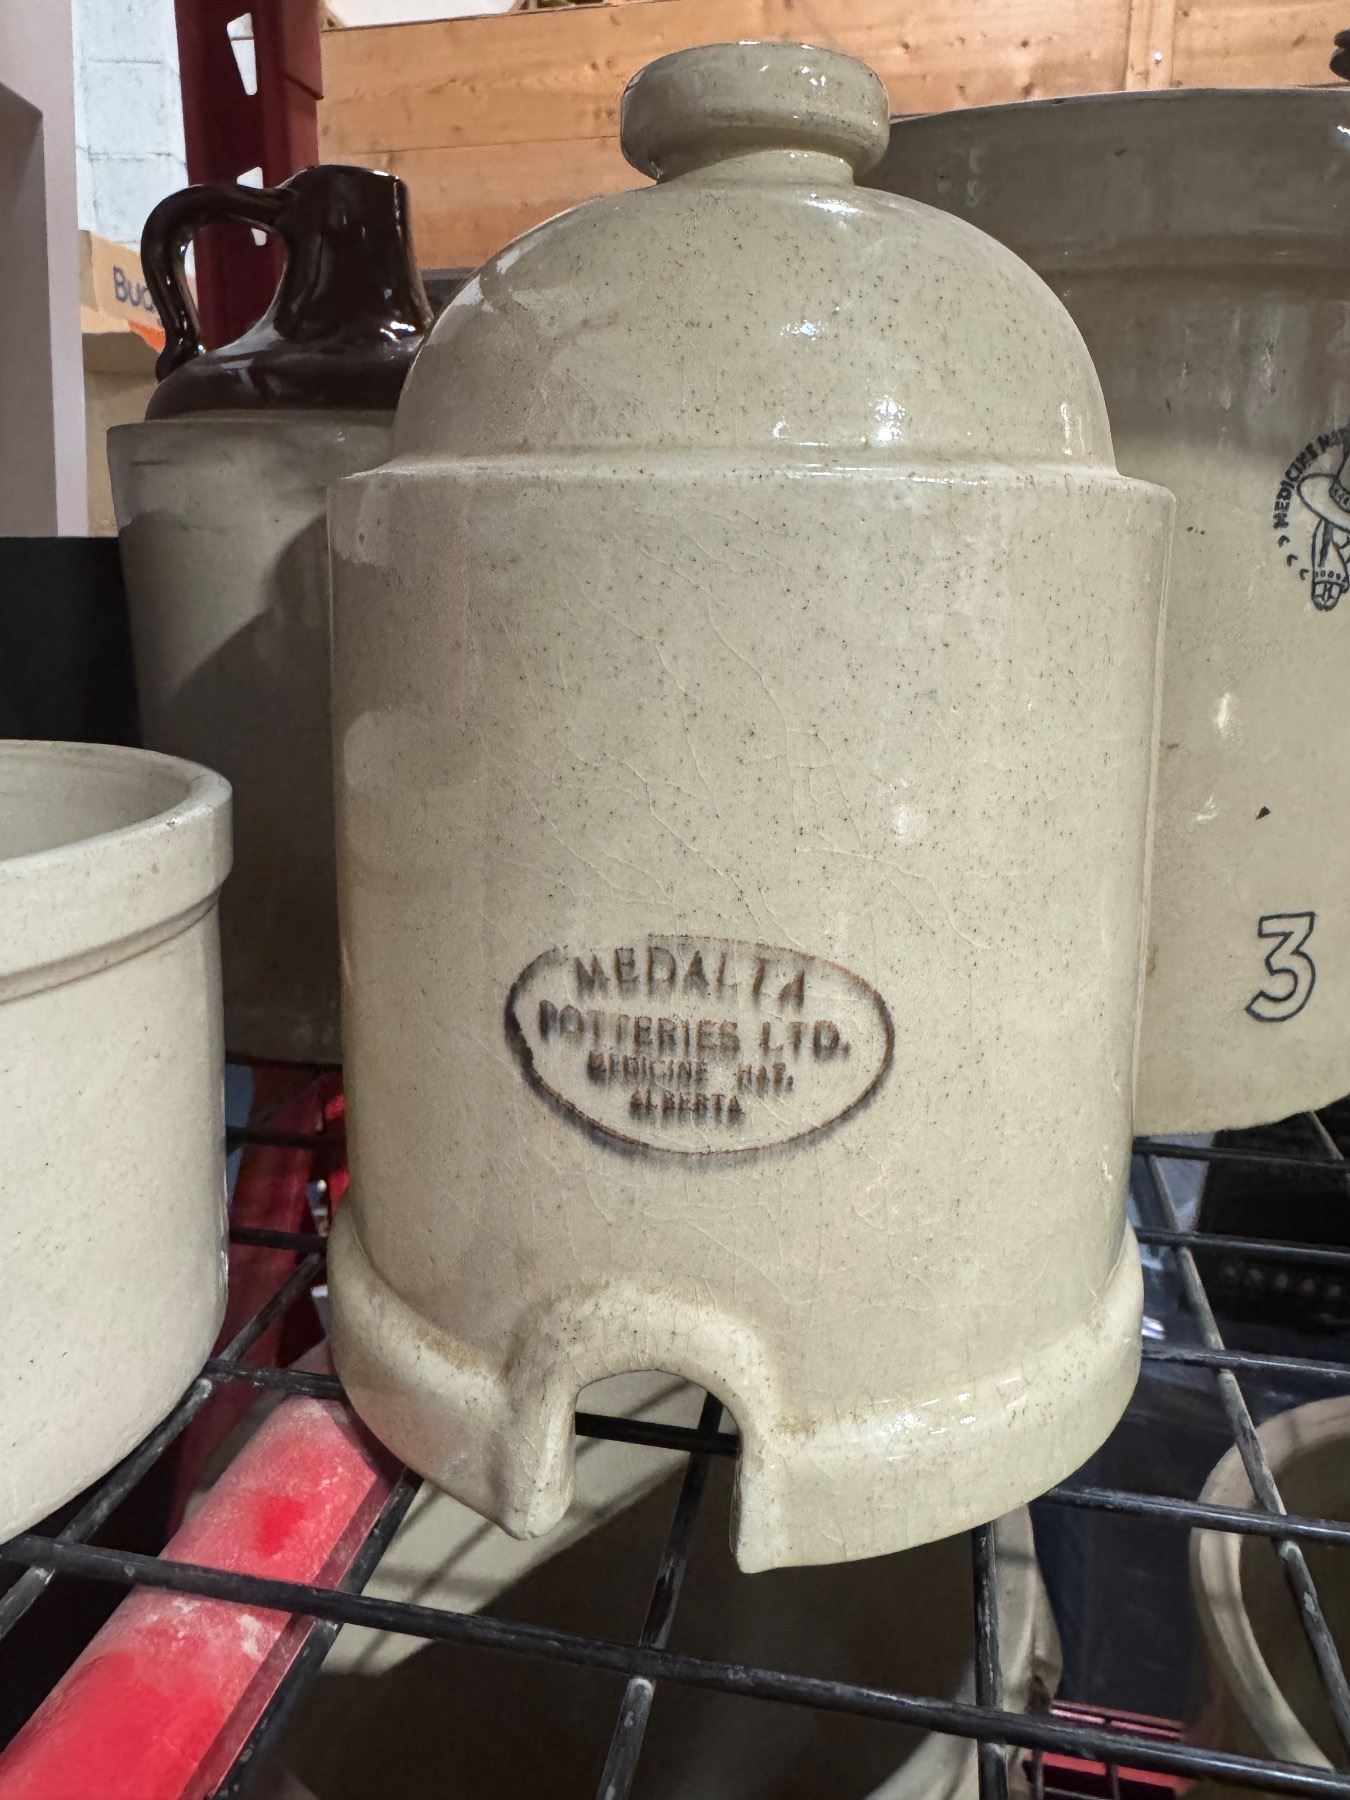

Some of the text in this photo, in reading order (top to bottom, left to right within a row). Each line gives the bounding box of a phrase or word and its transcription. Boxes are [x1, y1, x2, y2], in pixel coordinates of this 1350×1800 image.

[575, 946, 805, 1005] MEDALTA
[1245, 911, 1316, 1023] 3
[539, 999, 741, 1052] POTTERIES
[629, 1088, 745, 1119] ALBERTA
